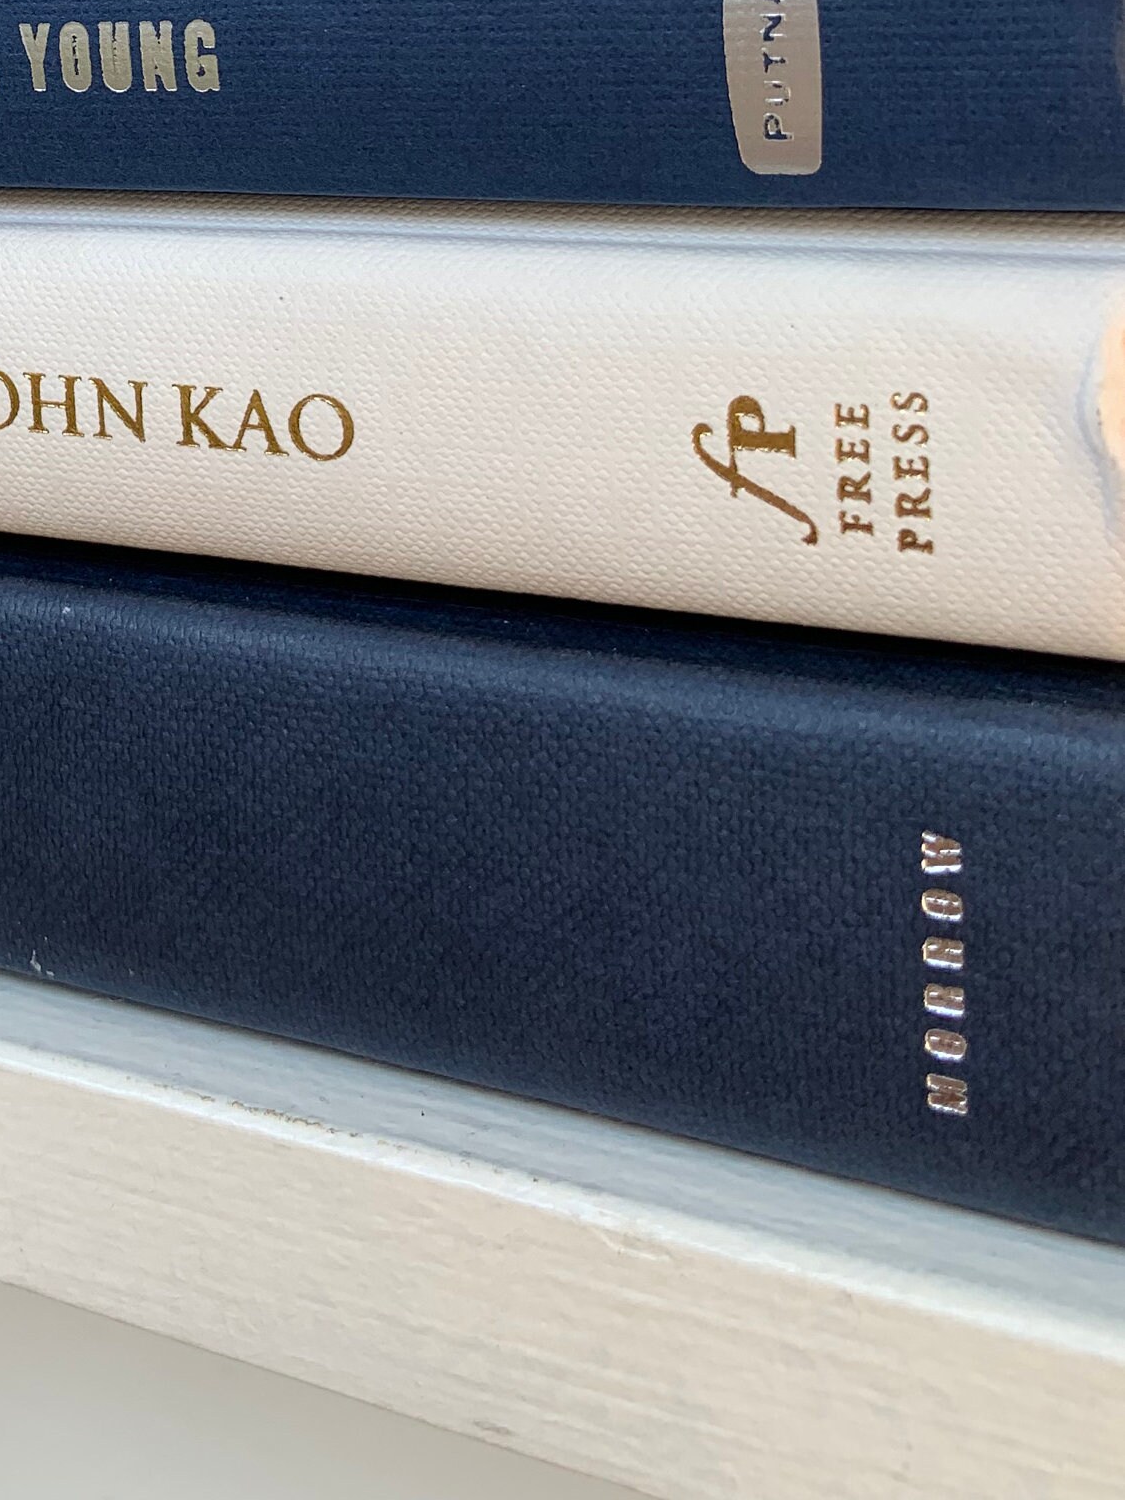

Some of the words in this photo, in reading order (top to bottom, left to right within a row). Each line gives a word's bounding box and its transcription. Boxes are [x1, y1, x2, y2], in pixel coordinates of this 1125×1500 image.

[18, 19, 221, 93] YOUNG
[172, 383, 355, 462] KAO
[834, 402, 874, 537] FREE
[890, 391, 934, 555] PRESS
[921, 830, 968, 1116] MORROW
